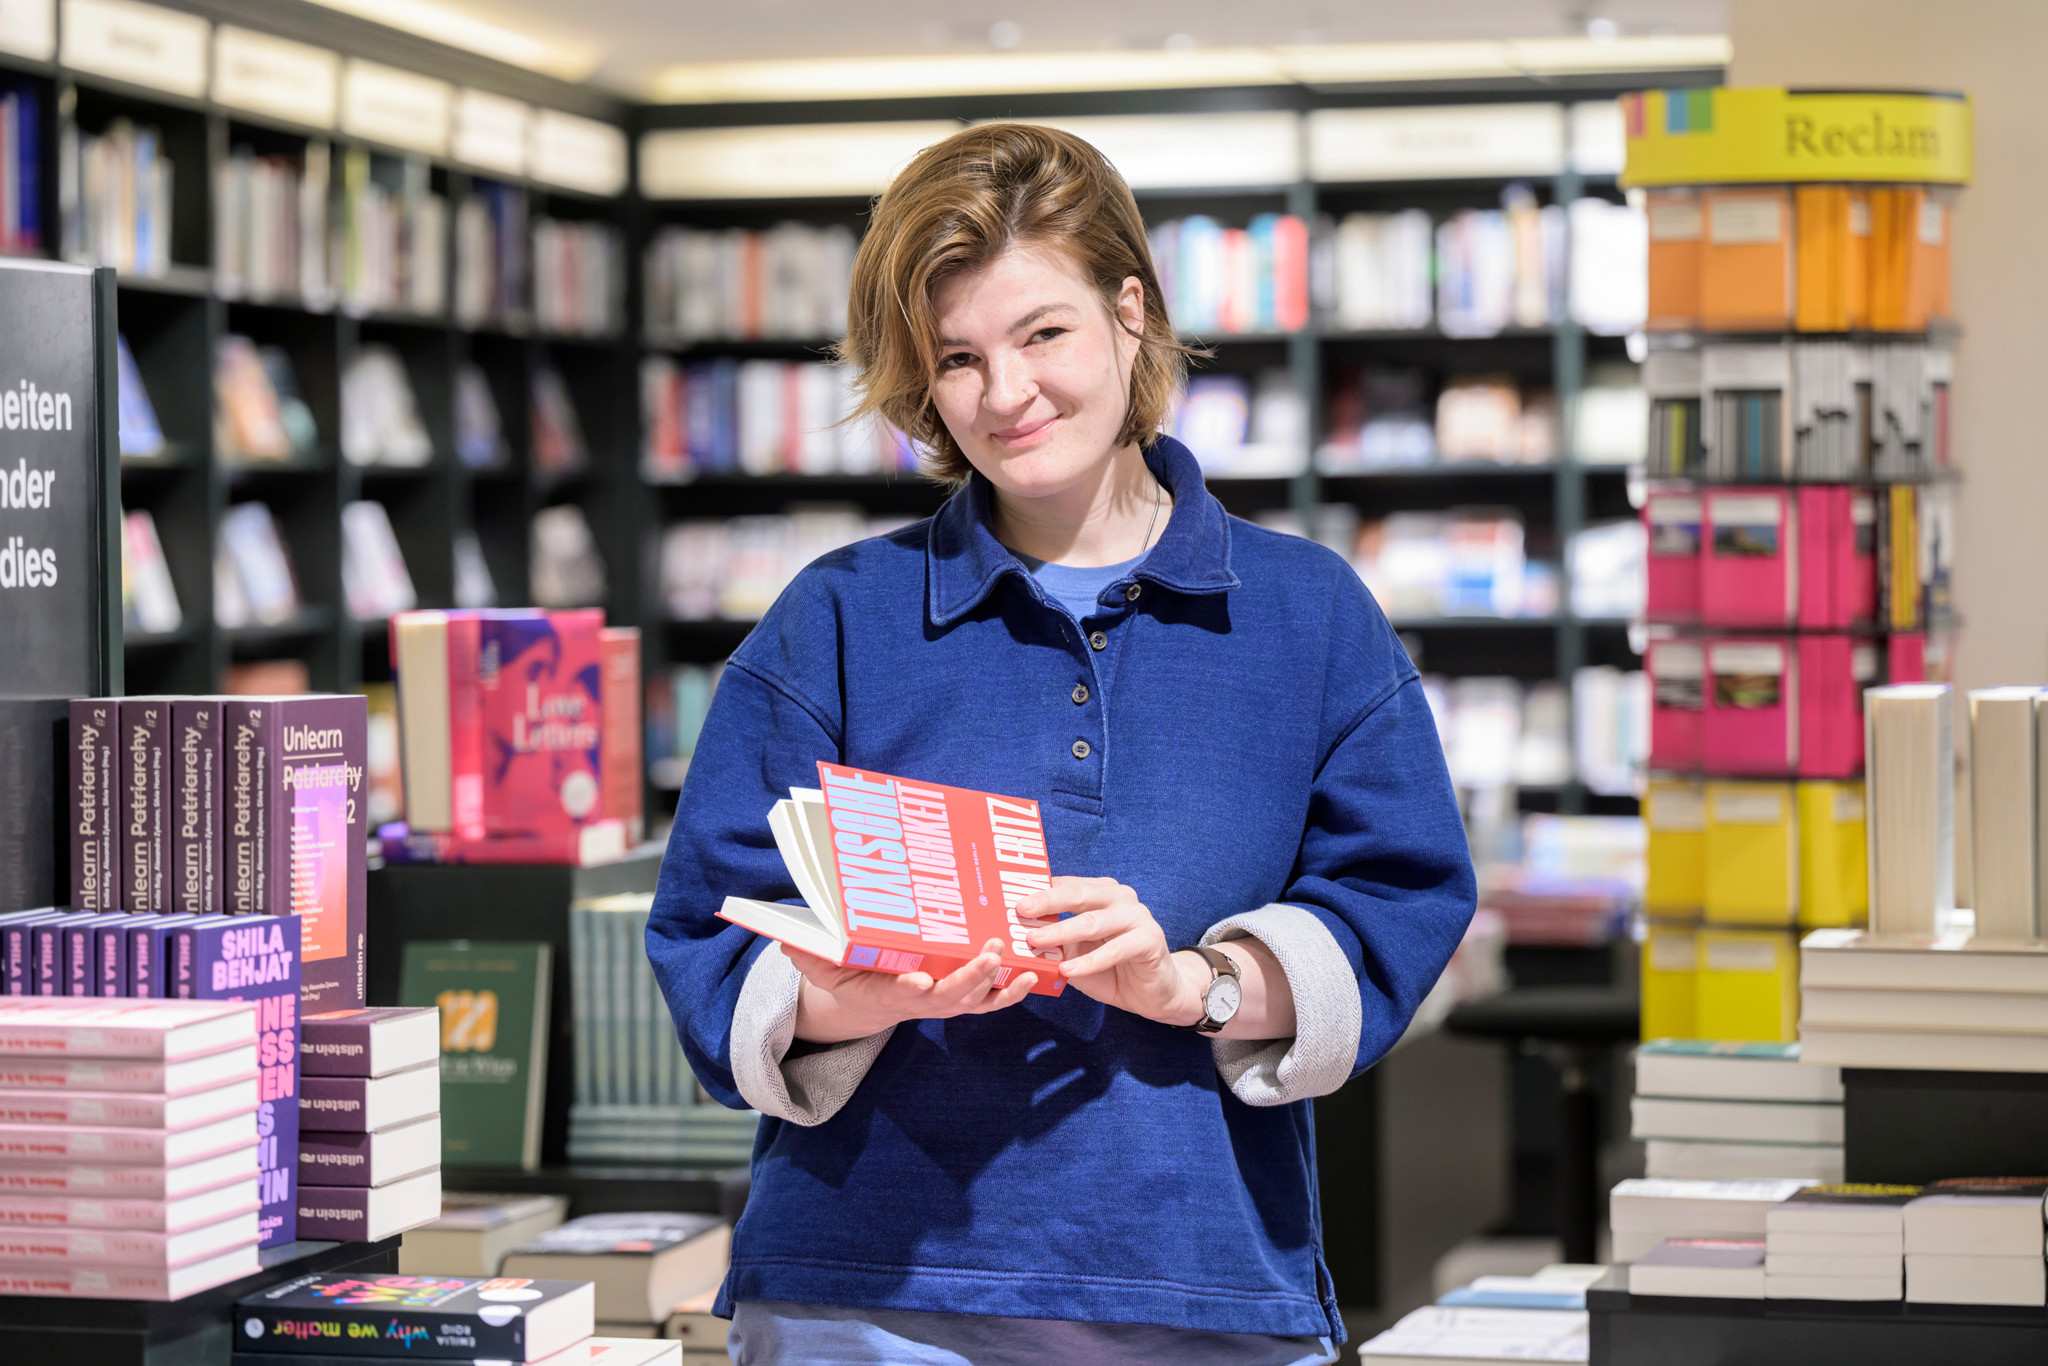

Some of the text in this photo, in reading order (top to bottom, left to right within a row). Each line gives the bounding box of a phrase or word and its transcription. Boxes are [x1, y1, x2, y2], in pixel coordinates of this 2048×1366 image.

[1785, 109, 1942, 159] Reclam
[0, 379, 72, 431] eiten
[0, 536, 58, 588] dies
[284, 724, 343, 752] Unlearn
[79, 724, 99, 836] Patriarchy
[130, 725, 151, 837] Patriarchy
[181, 726, 202, 839] Patriarchy
[234, 724, 255, 838] Patriarchy
[283, 760, 362, 792] Patriarchy
[823, 767, 920, 935] TOXISCHE
[986, 796, 1048, 868] FRITZ
[79, 841, 96, 912] nlearn
[182, 844, 198, 915] nlearn
[895, 781, 970, 944] WEIBLICHKEIT
[221, 924, 285, 961] SHILA
[212, 951, 293, 991] BEHJAT
[356, 951, 364, 1000] ullstein
[315, 1043, 363, 1057] ullstein
[312, 1099, 360, 1112] ullstein
[317, 1153, 364, 1166] ullstein
[315, 1207, 363, 1221] ullstein
[273, 1318, 430, 1349] why we matter
[435, 1336, 476, 1348] EMILIA
